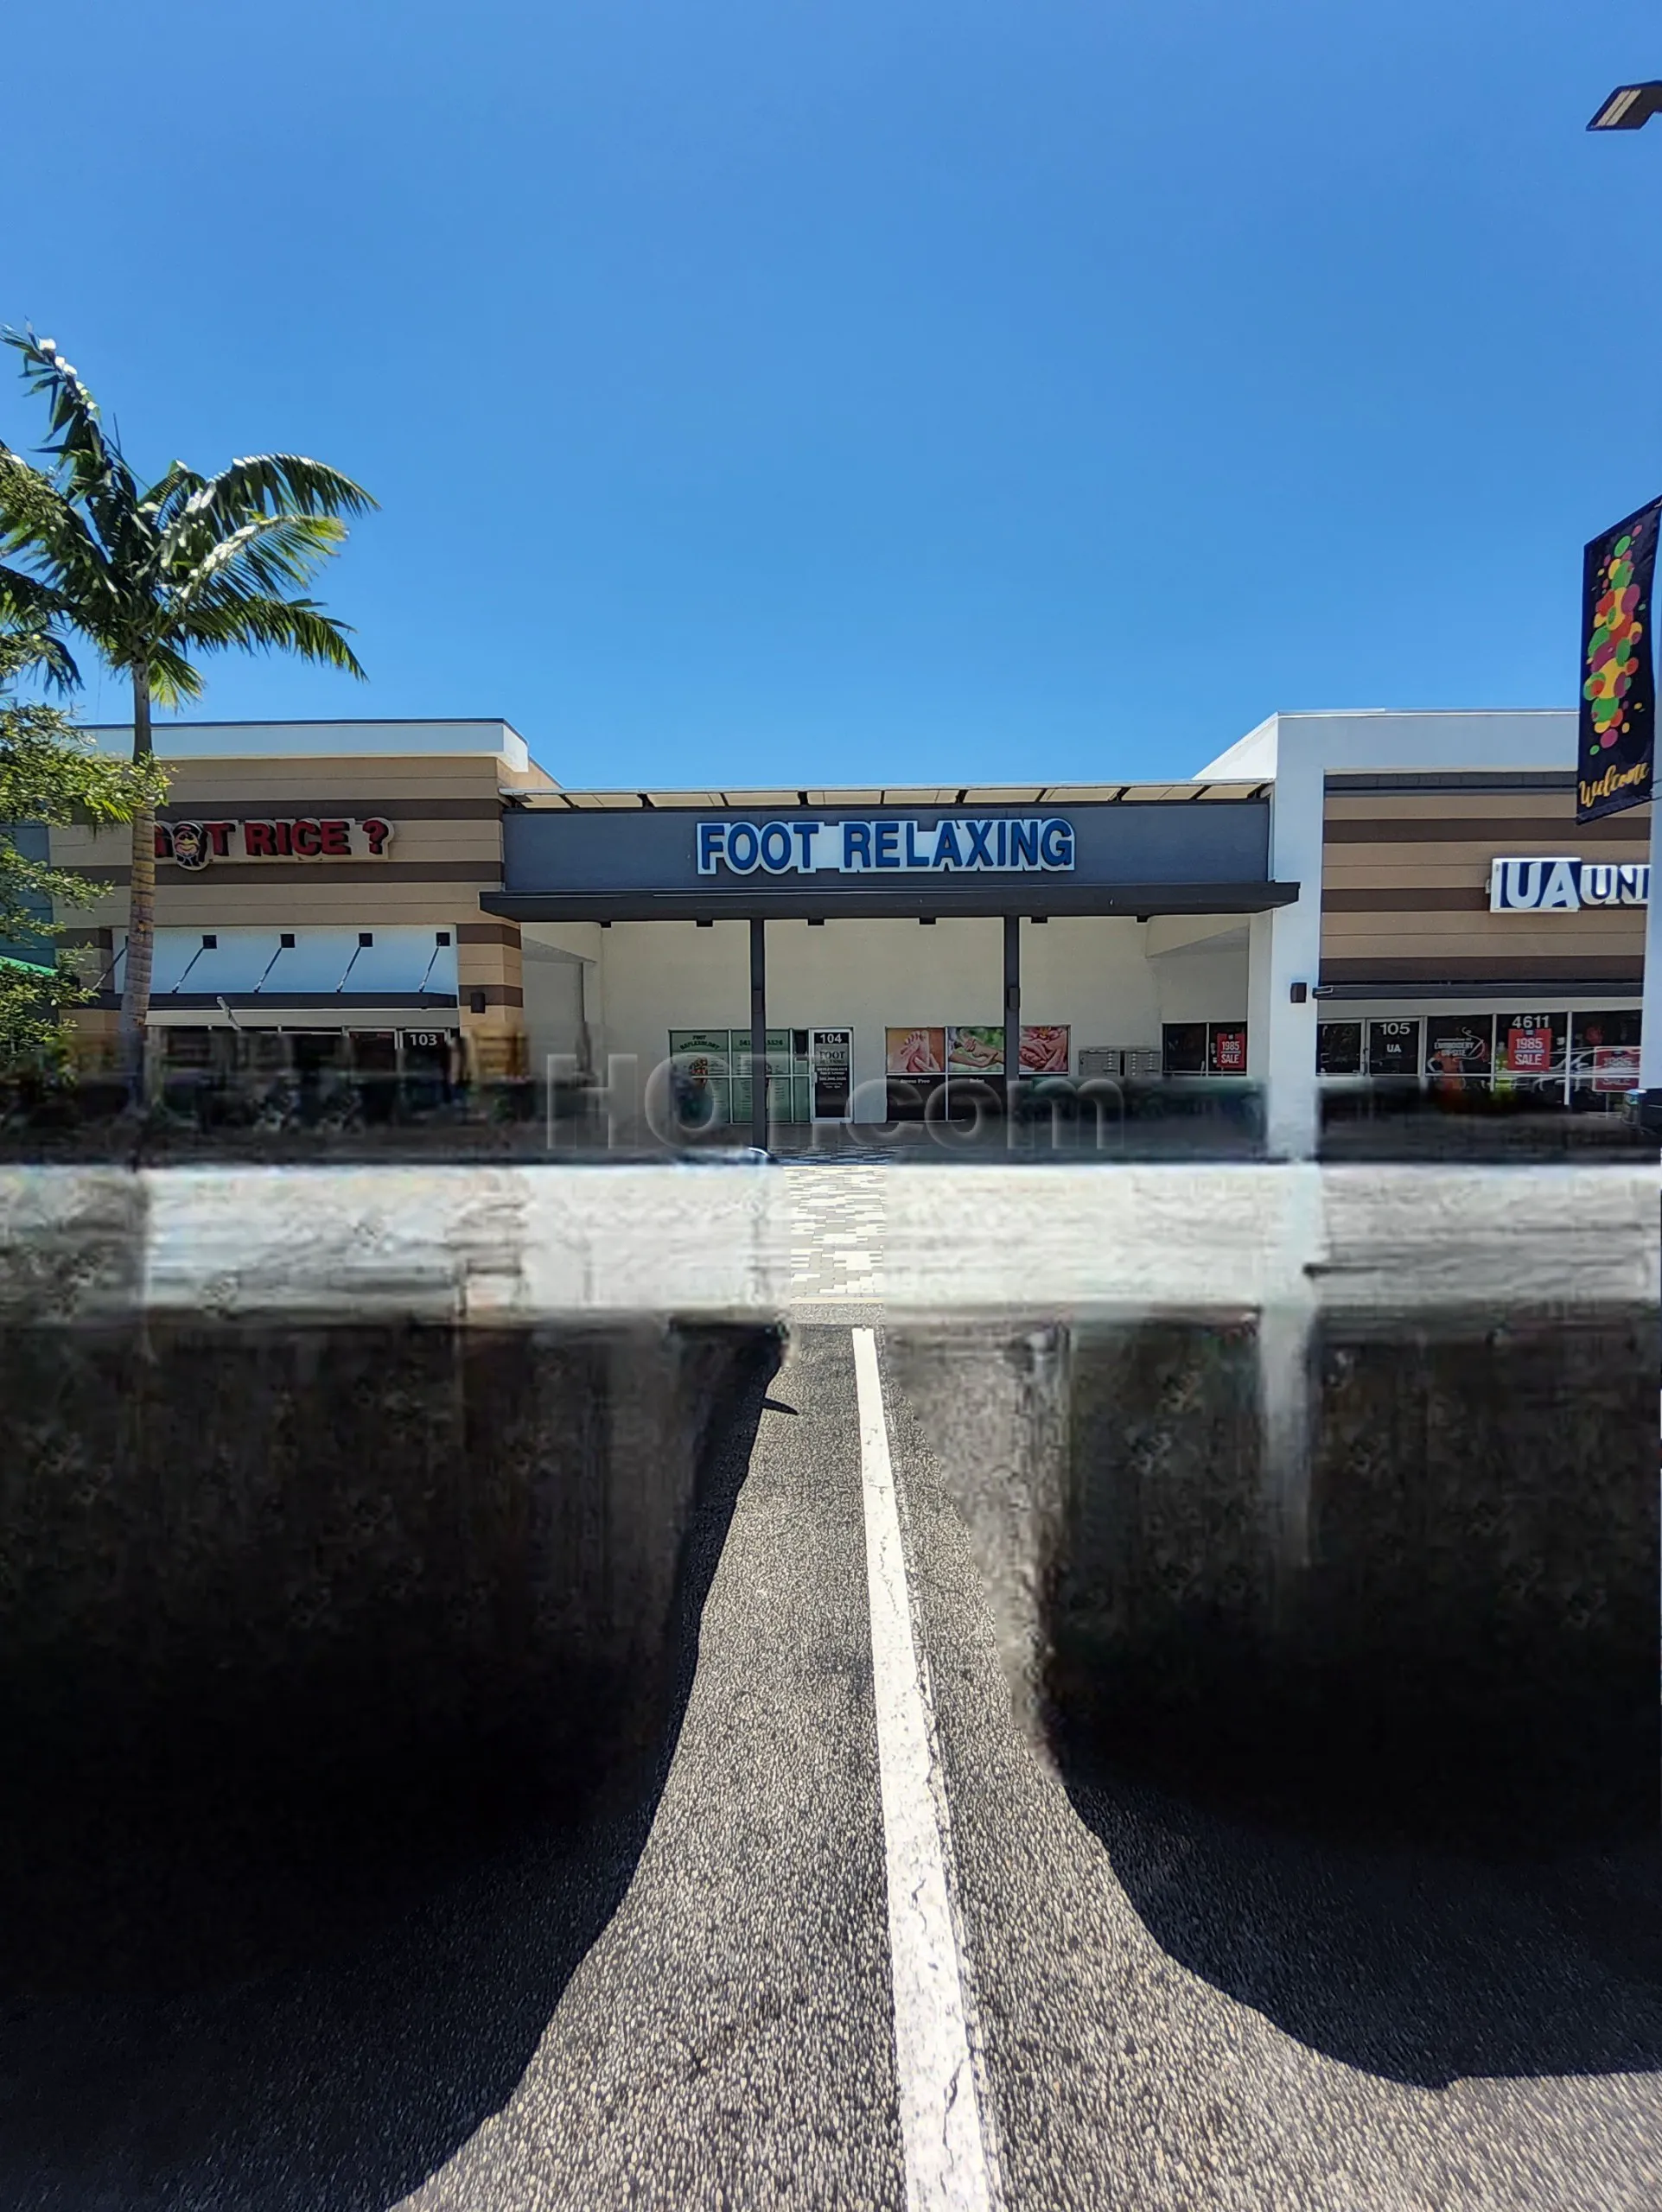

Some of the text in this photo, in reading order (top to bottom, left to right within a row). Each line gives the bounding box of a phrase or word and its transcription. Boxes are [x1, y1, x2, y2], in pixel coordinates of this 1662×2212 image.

[1579, 762, 1650, 807] Welcome
[245, 821, 352, 856] RICE
[701, 819, 1073, 870] FOOT RELAXING
[1505, 862, 1581, 908] UA
[1512, 1015, 1550, 1028] 4611
[1380, 1023, 1410, 1035] 105
[410, 1034, 437, 1046] 103
[820, 1033, 843, 1044] 104
[1516, 1038, 1544, 1049] 1985
[1221, 1041, 1240, 1051] 1985
[1386, 1044, 1402, 1053] UA
[819, 1051, 845, 1060] FOOT
[1221, 1054, 1239, 1064] SALE
[1515, 1053, 1543, 1065] SALE
